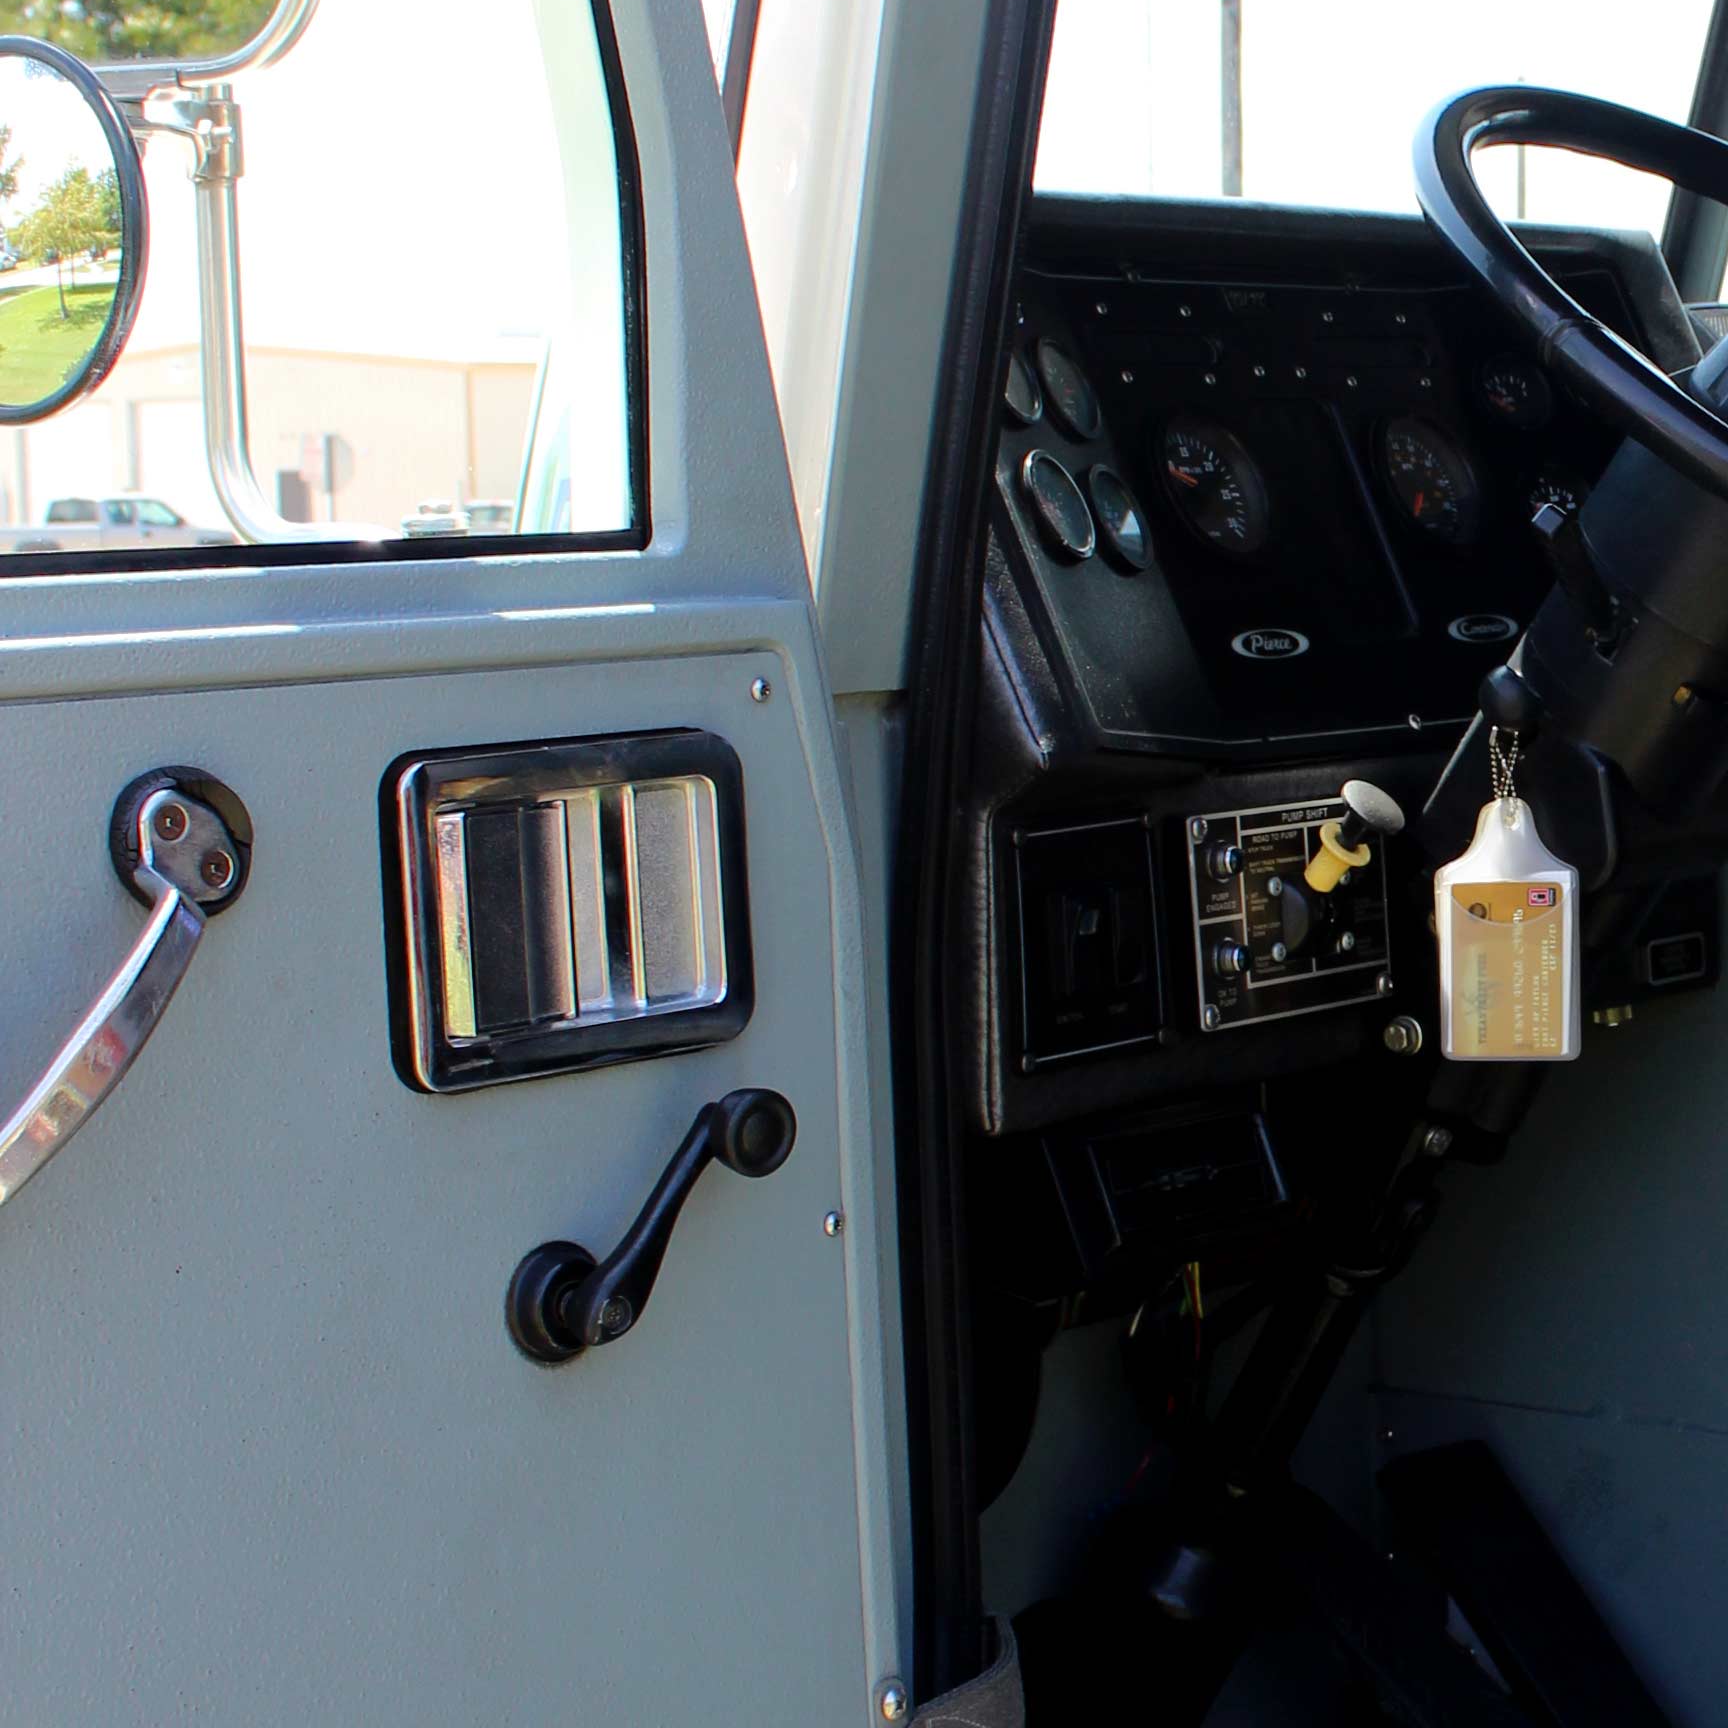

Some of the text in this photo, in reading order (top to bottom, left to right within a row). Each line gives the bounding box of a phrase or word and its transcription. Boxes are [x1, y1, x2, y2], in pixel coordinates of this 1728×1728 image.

[1250, 633, 1293, 653] Pierce
[1281, 807, 1328, 823] PUMP SHIFT
